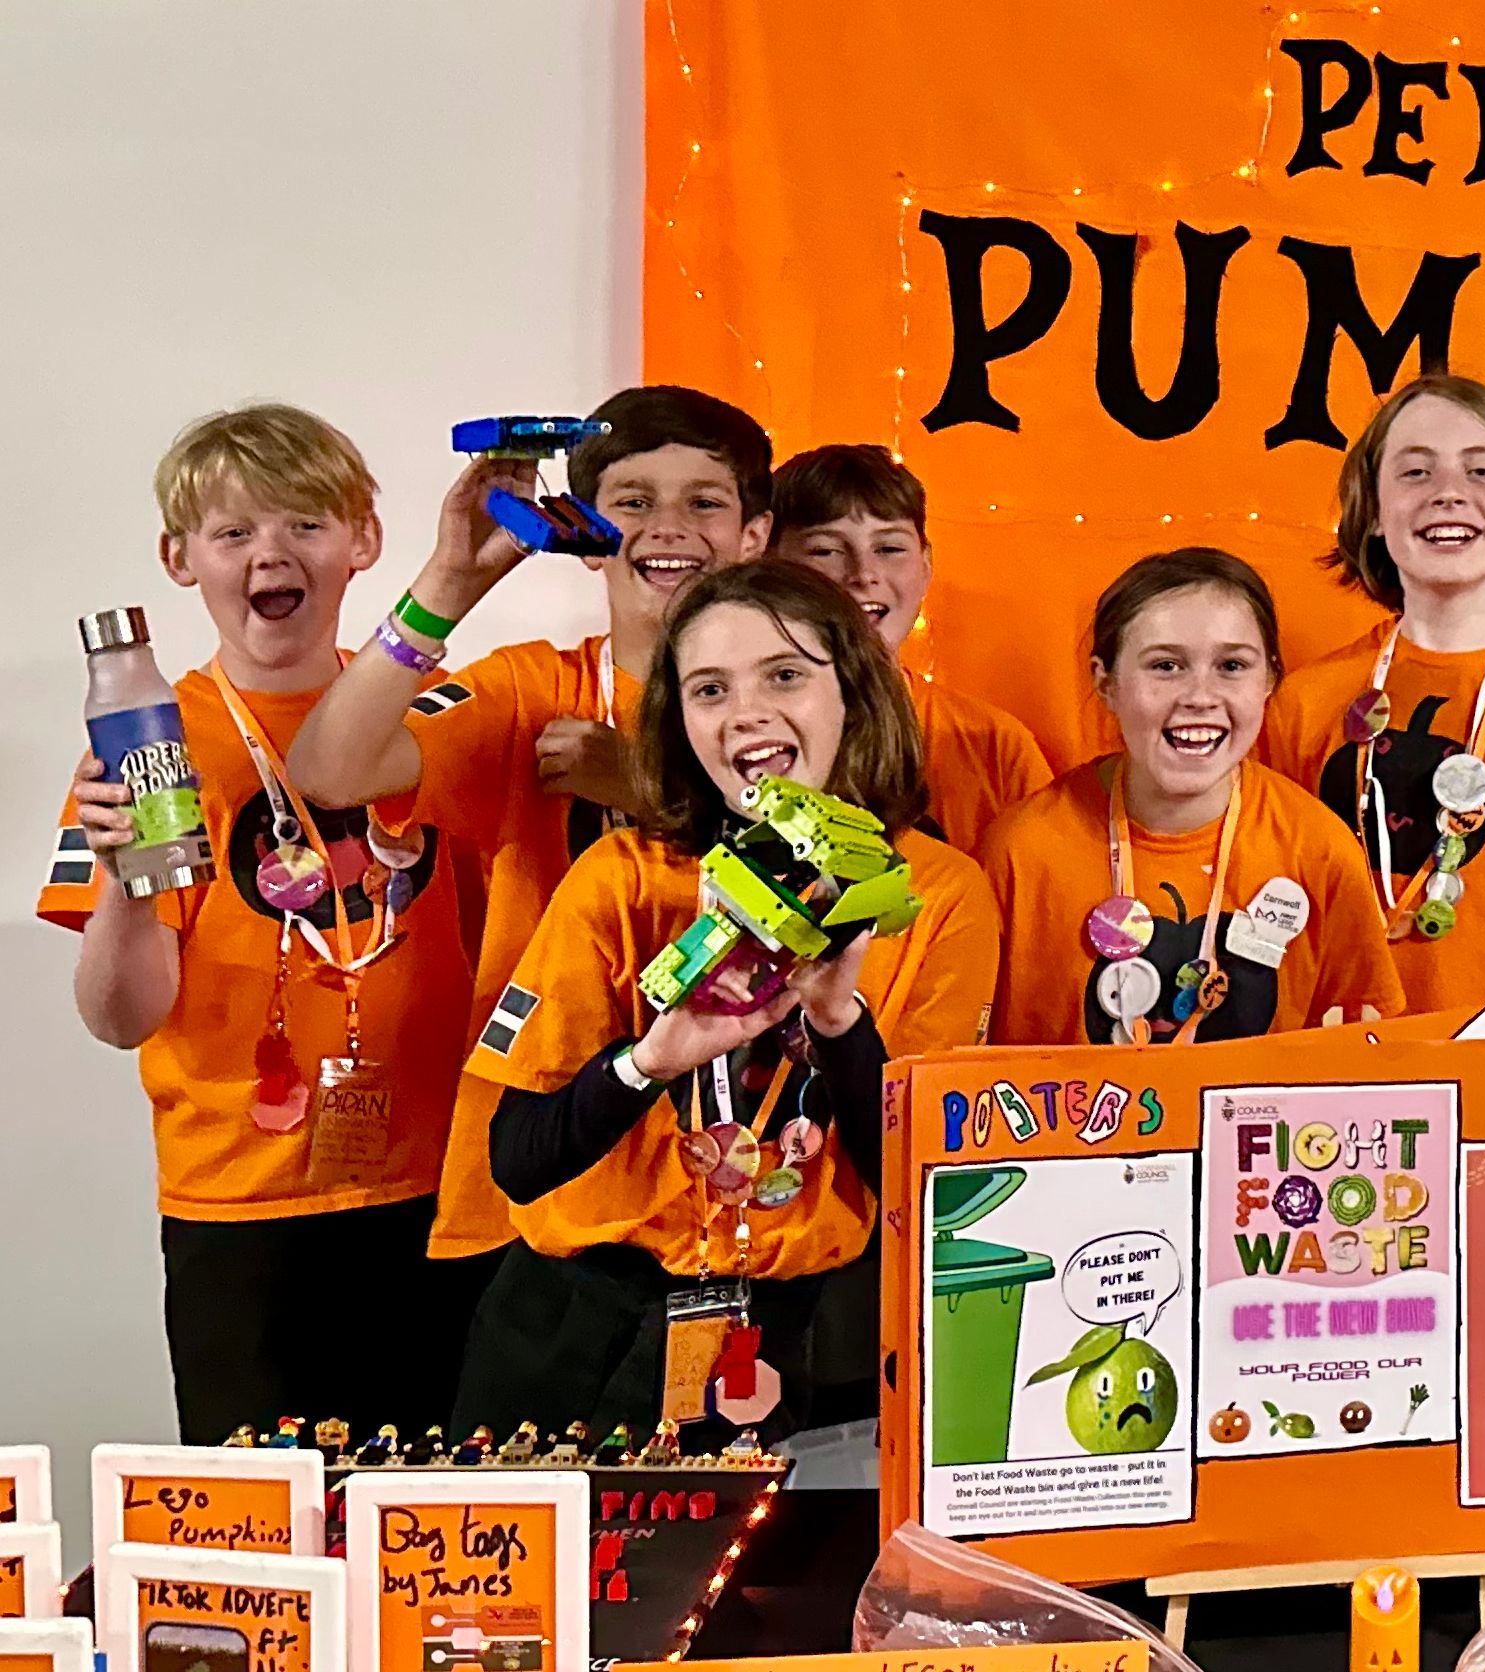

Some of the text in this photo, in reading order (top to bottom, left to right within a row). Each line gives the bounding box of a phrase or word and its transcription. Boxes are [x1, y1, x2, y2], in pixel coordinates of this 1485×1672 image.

[943, 1079, 1164, 1152] POSTERS
[1237, 1119, 1430, 1173] FIGHT
[1235, 1173, 1430, 1229] FOOD
[1079, 1247, 1161, 1270] PLEASE DON'T
[1233, 1225, 1430, 1277] WASTE
[1100, 1270, 1144, 1287] PUT ME
[1096, 1289, 1155, 1308] IN THERE!
[1232, 1296, 1436, 1342] USE THE NEW BINS
[1239, 1357, 1422, 1376] YOUR FOOD OUR
[1292, 1370, 1370, 1383] POWER
[952, 1471, 979, 1482] Don't
[981, 1471, 994, 1480] let
[997, 1469, 1023, 1480] Food
[1024, 1467, 1058, 1478] Waste
[1060, 1467, 1073, 1477] go
[1075, 1466, 1086, 1474] to
[1088, 1463, 1119, 1473] waste
[1127, 1461, 1145, 1472] put
[1147, 1459, 1155, 1469] it
[1156, 1459, 1167, 1469] in
[956, 1488, 973, 1498] the
[975, 1486, 1001, 1497] Food
[1003, 1484, 1036, 1495] Waste
[1038, 1483, 1054, 1492] bin
[1057, 1481, 1076, 1491] and
[1077, 1480, 1099, 1492] give
[1102, 1479, 1110, 1488] it
[1119, 1477, 1141, 1486] new
[124, 1479, 210, 1514] Lego
[379, 1506, 446, 1563] Bag
[460, 1505, 528, 1572] tags
[382, 1566, 513, 1608] by James
